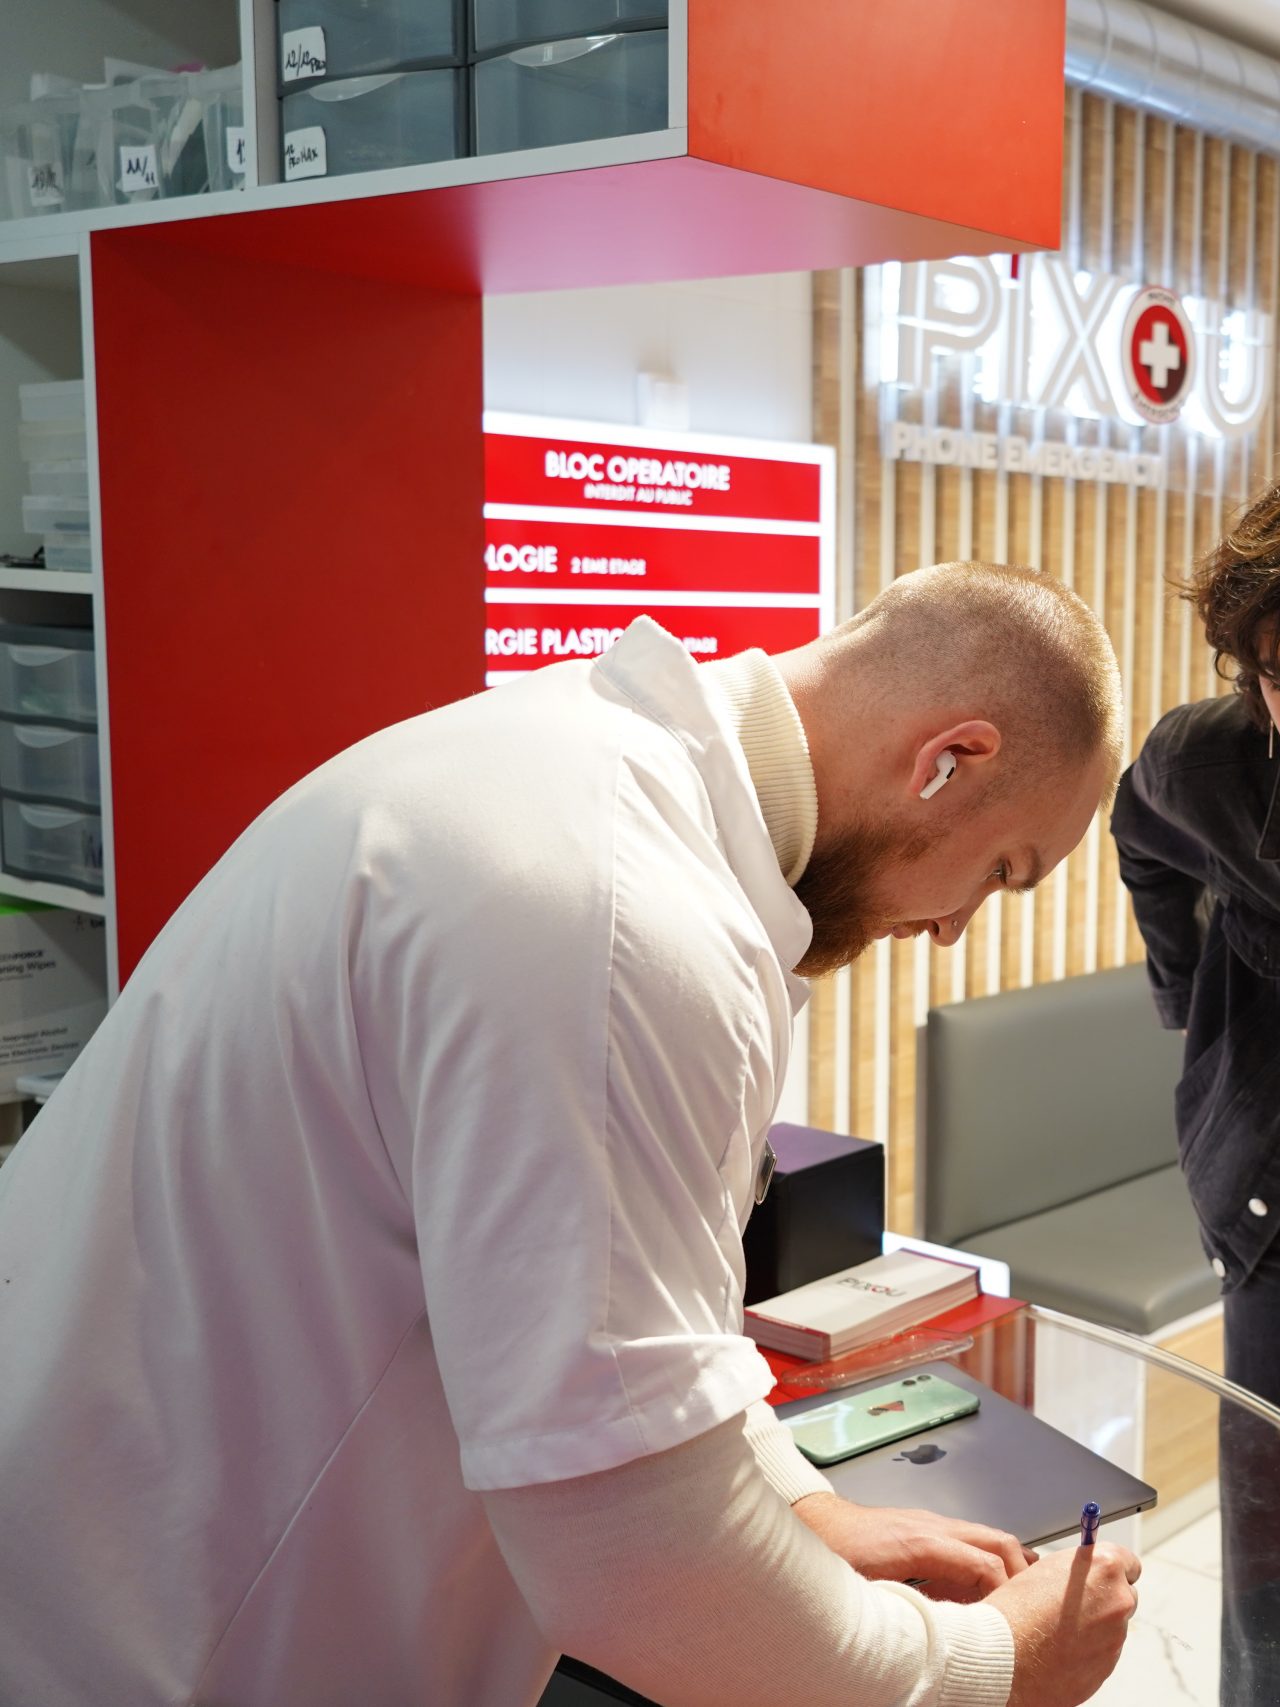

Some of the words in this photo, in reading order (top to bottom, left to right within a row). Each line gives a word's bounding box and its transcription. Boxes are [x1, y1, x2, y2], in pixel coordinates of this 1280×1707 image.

[893, 421, 999, 471] PHONE
[544, 449, 605, 482] BLOC
[605, 455, 731, 492] OPERATOIRE
[636, 486, 655, 503] AU
[484, 543, 558, 573] LOGIE
[571, 556, 581, 574] 2
